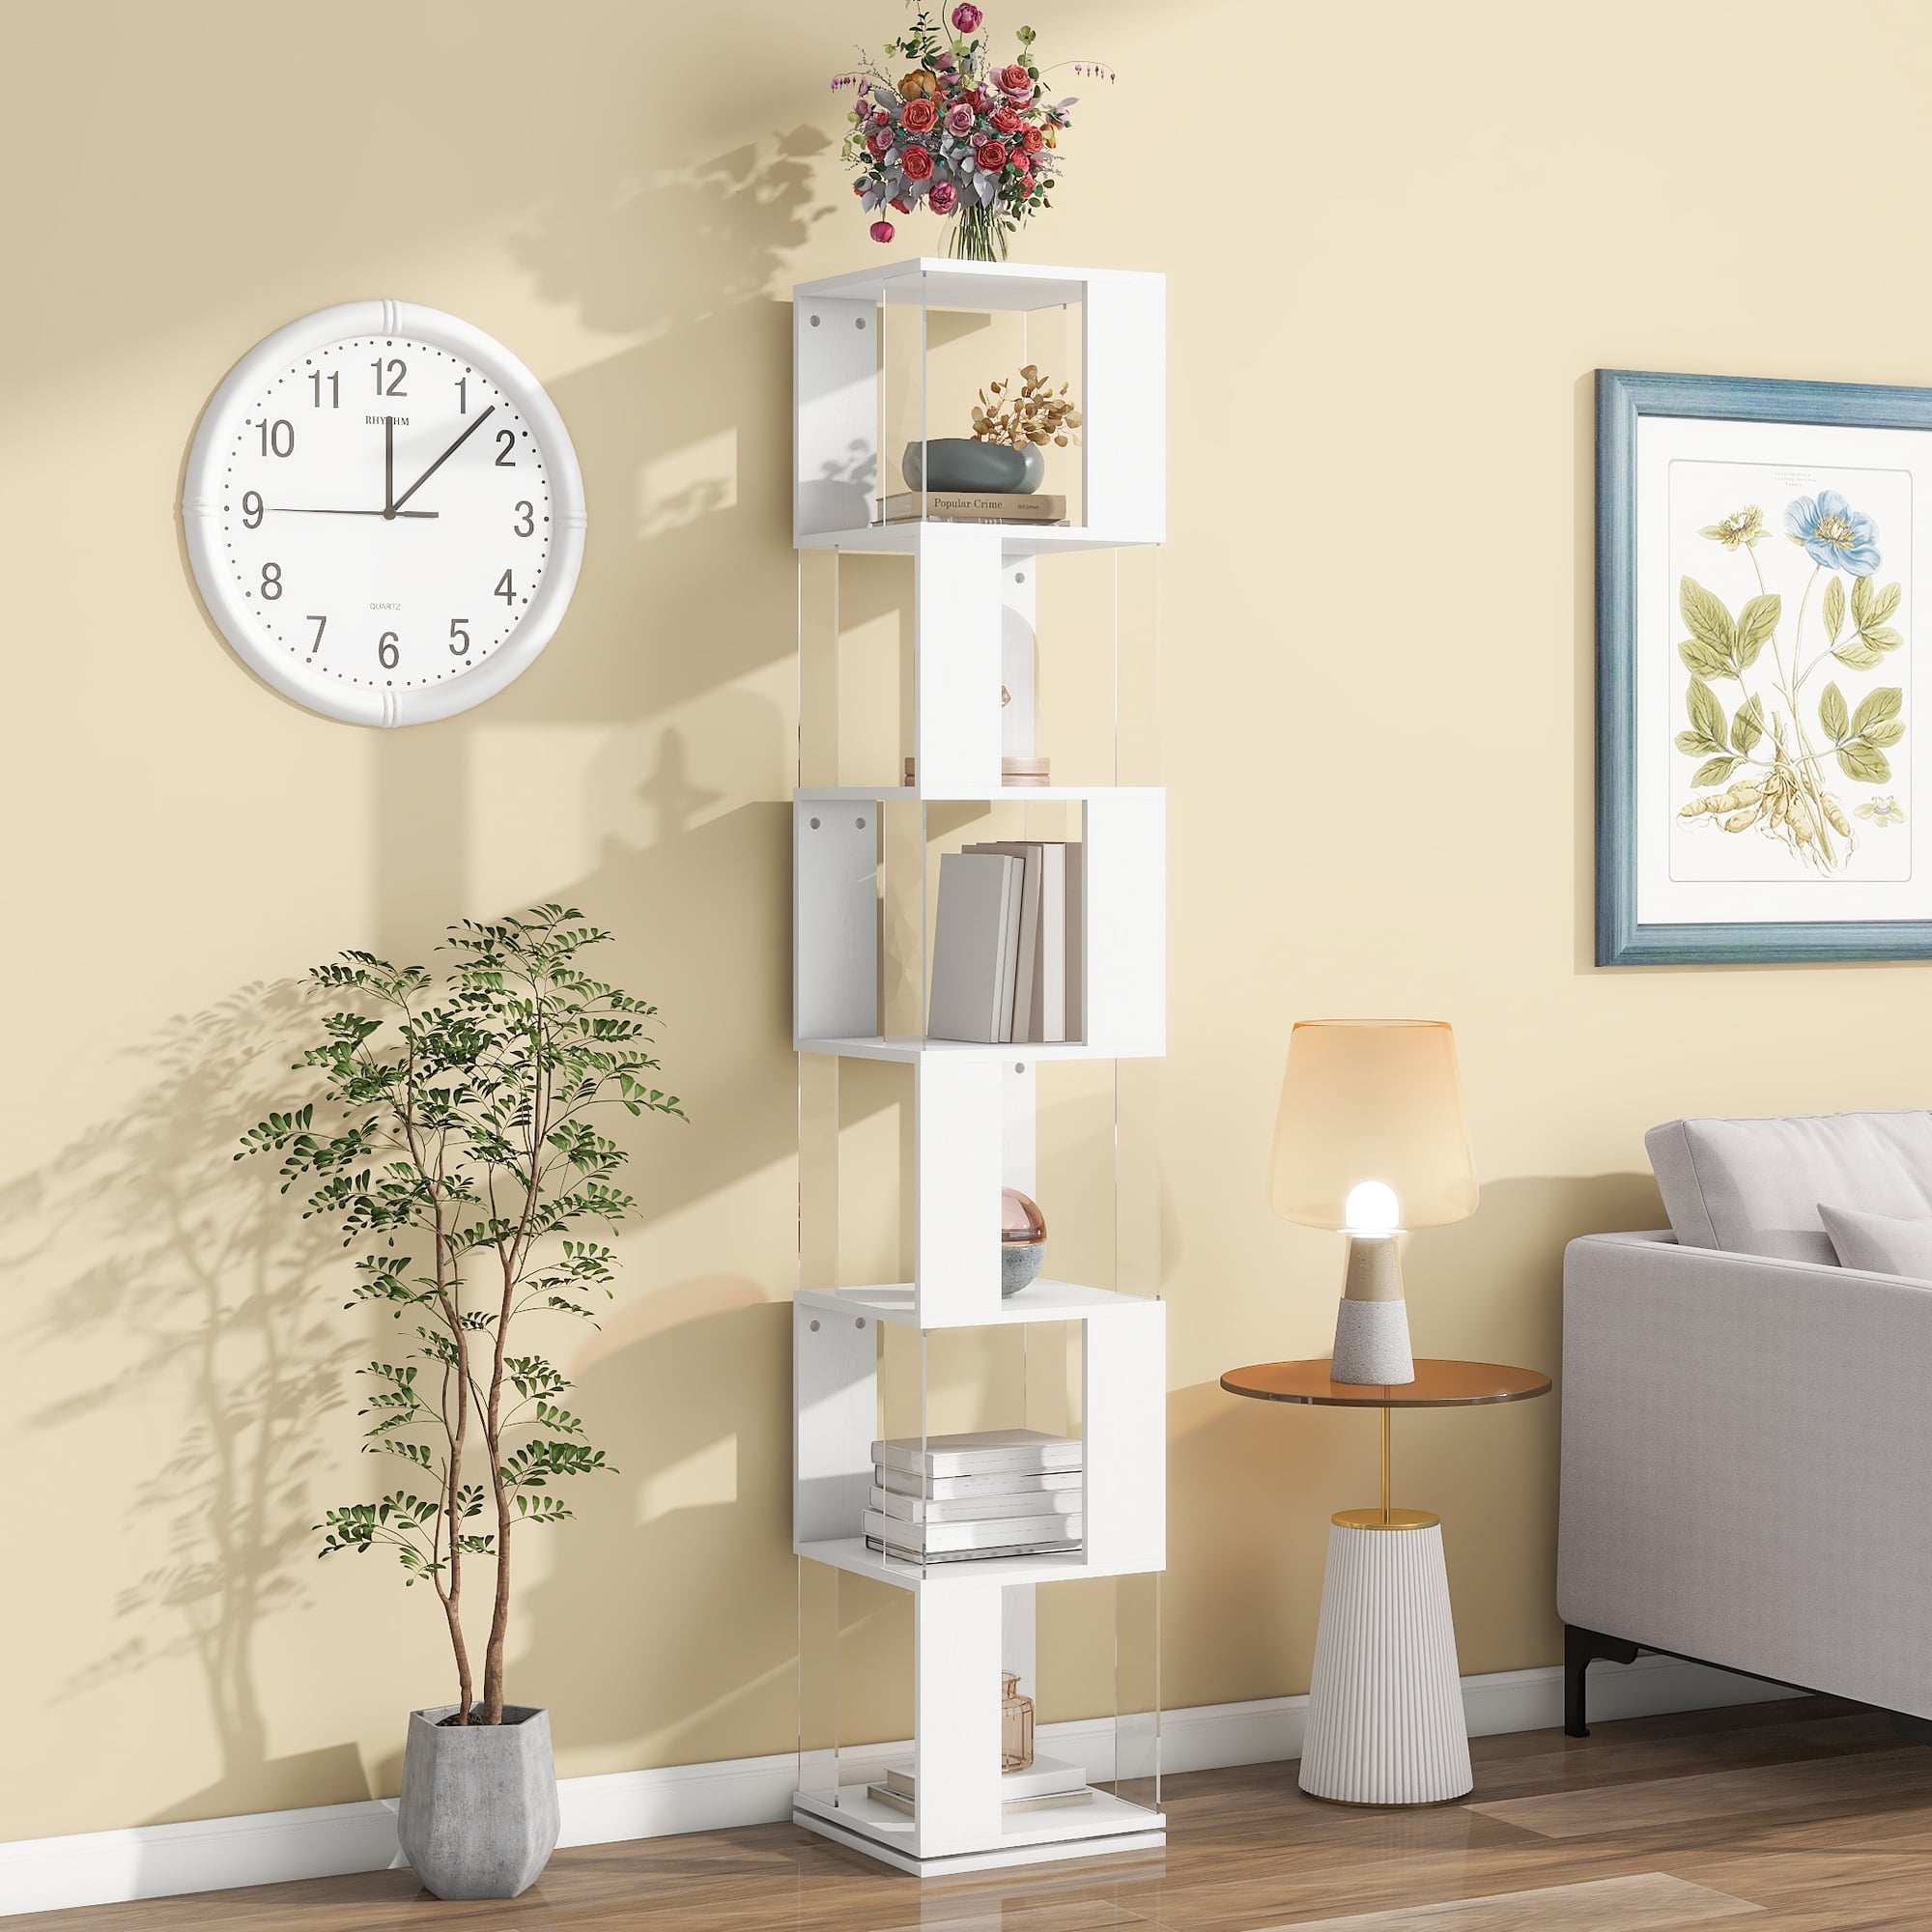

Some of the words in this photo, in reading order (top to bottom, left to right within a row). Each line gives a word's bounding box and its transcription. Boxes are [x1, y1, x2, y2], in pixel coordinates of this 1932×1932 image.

[308, 370, 338, 408] 11
[371, 358, 407, 396] 12
[455, 378, 466, 413] 1
[256, 419, 294, 458] 10
[365, 415, 410, 425] RHYHM
[496, 430, 516, 467] 2
[242, 491, 264, 528] 9
[514, 501, 534, 537] 3
[934, 498, 971, 509] Popular
[974, 498, 1003, 509] Crime
[261, 563, 282, 600] 8
[495, 569, 516, 606] 4
[307, 615, 327, 652] 7
[379, 632, 399, 668] 6
[449, 619, 469, 655] 5
